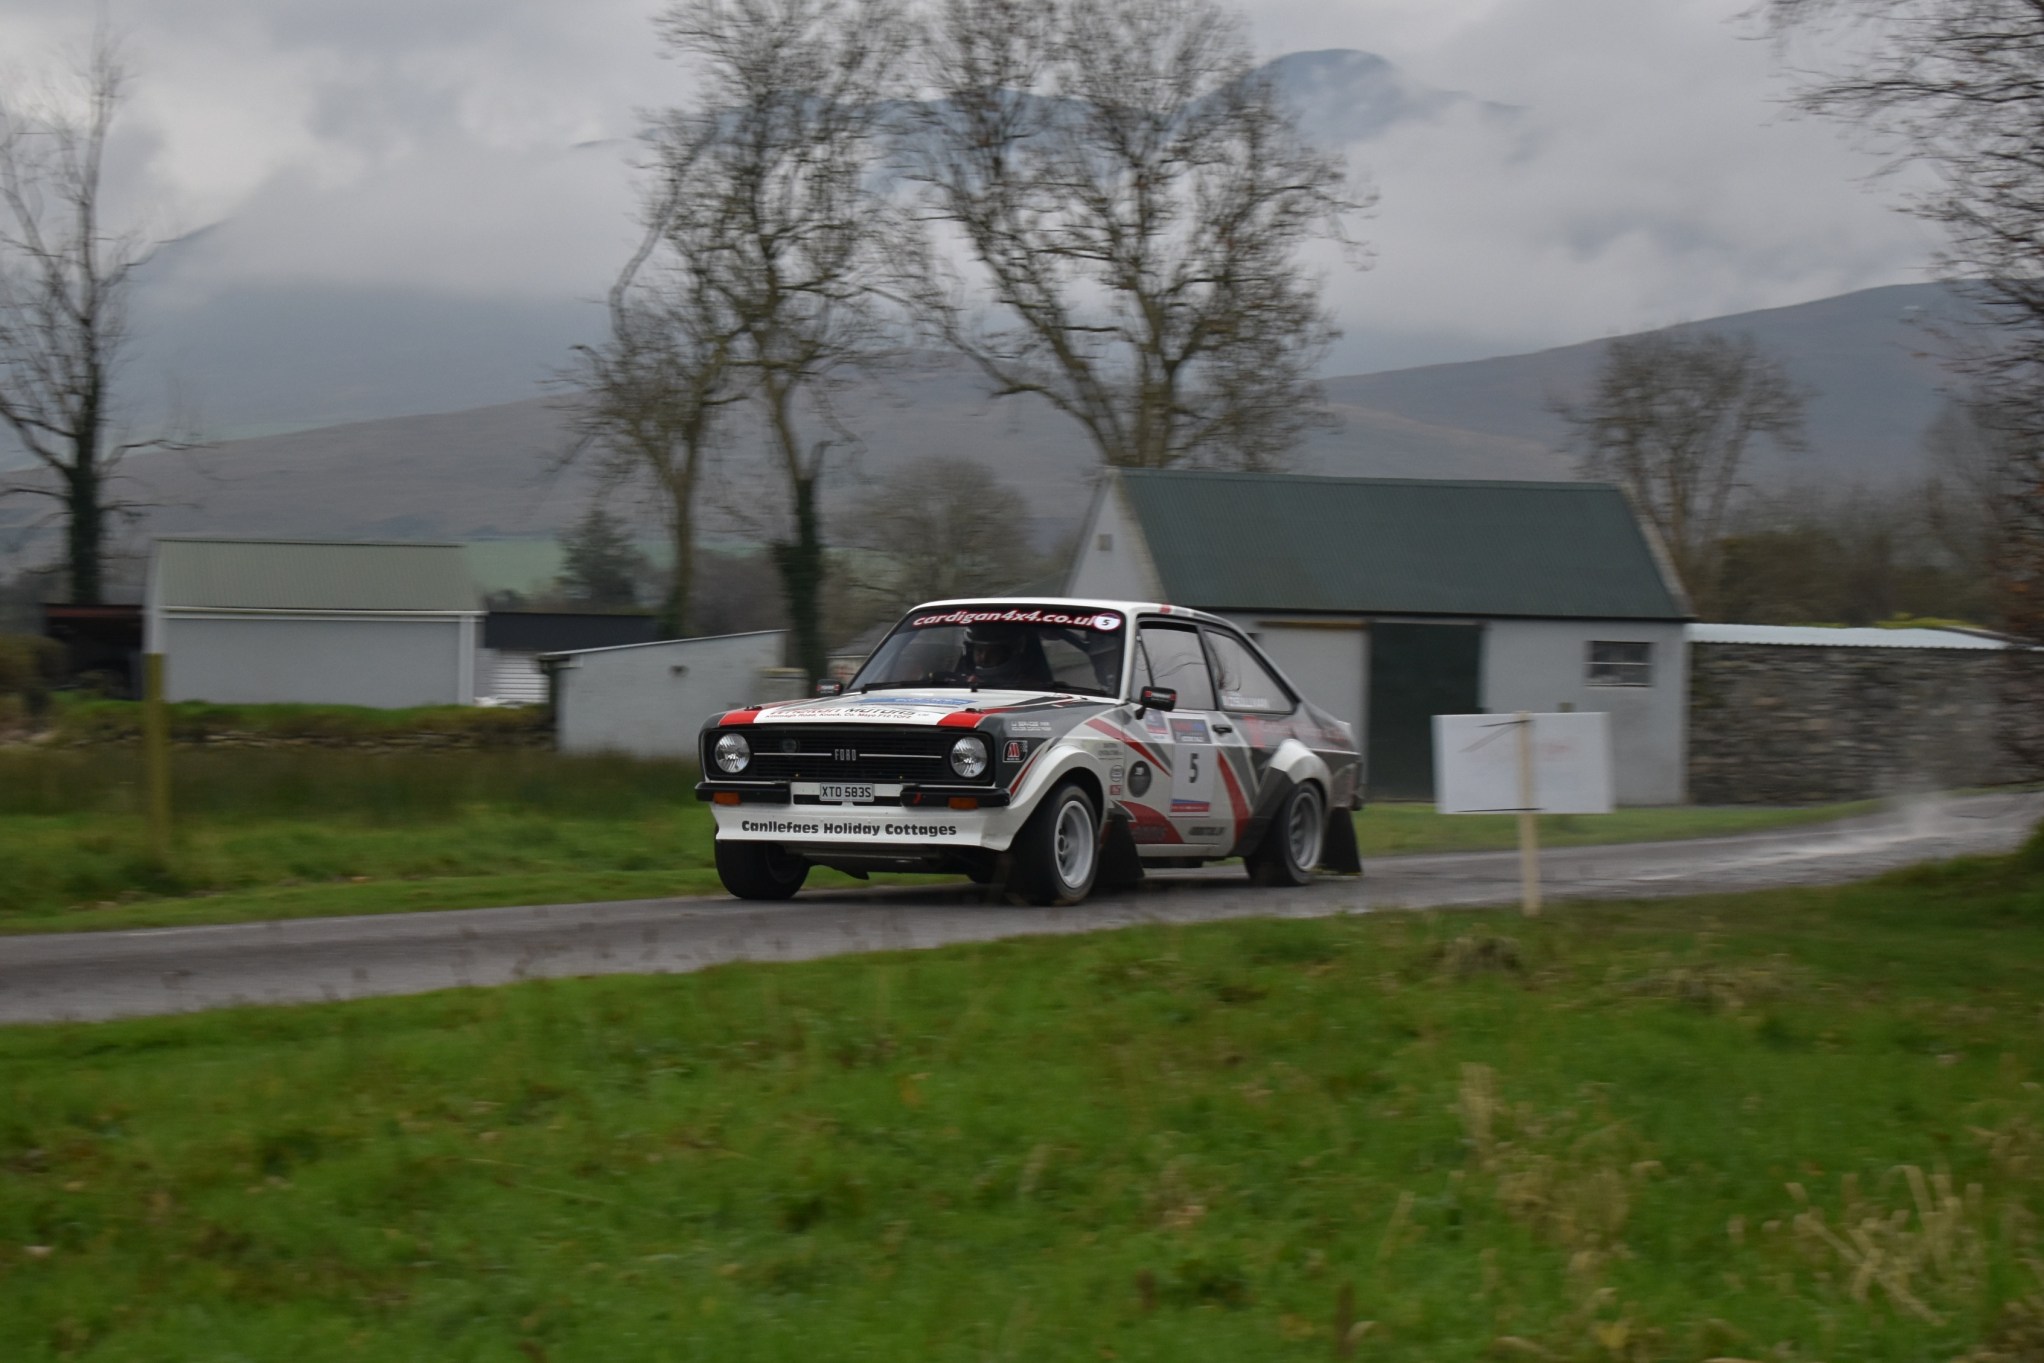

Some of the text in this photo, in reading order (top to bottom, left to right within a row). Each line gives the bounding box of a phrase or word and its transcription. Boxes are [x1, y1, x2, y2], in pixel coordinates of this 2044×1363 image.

[1101, 618, 1111, 626] 5
[834, 749, 857, 761] FORD
[1188, 752, 1200, 784] 5
[822, 786, 872, 798] XTO 583S
[741, 820, 957, 837] Canllefaes Holiday Cottages
